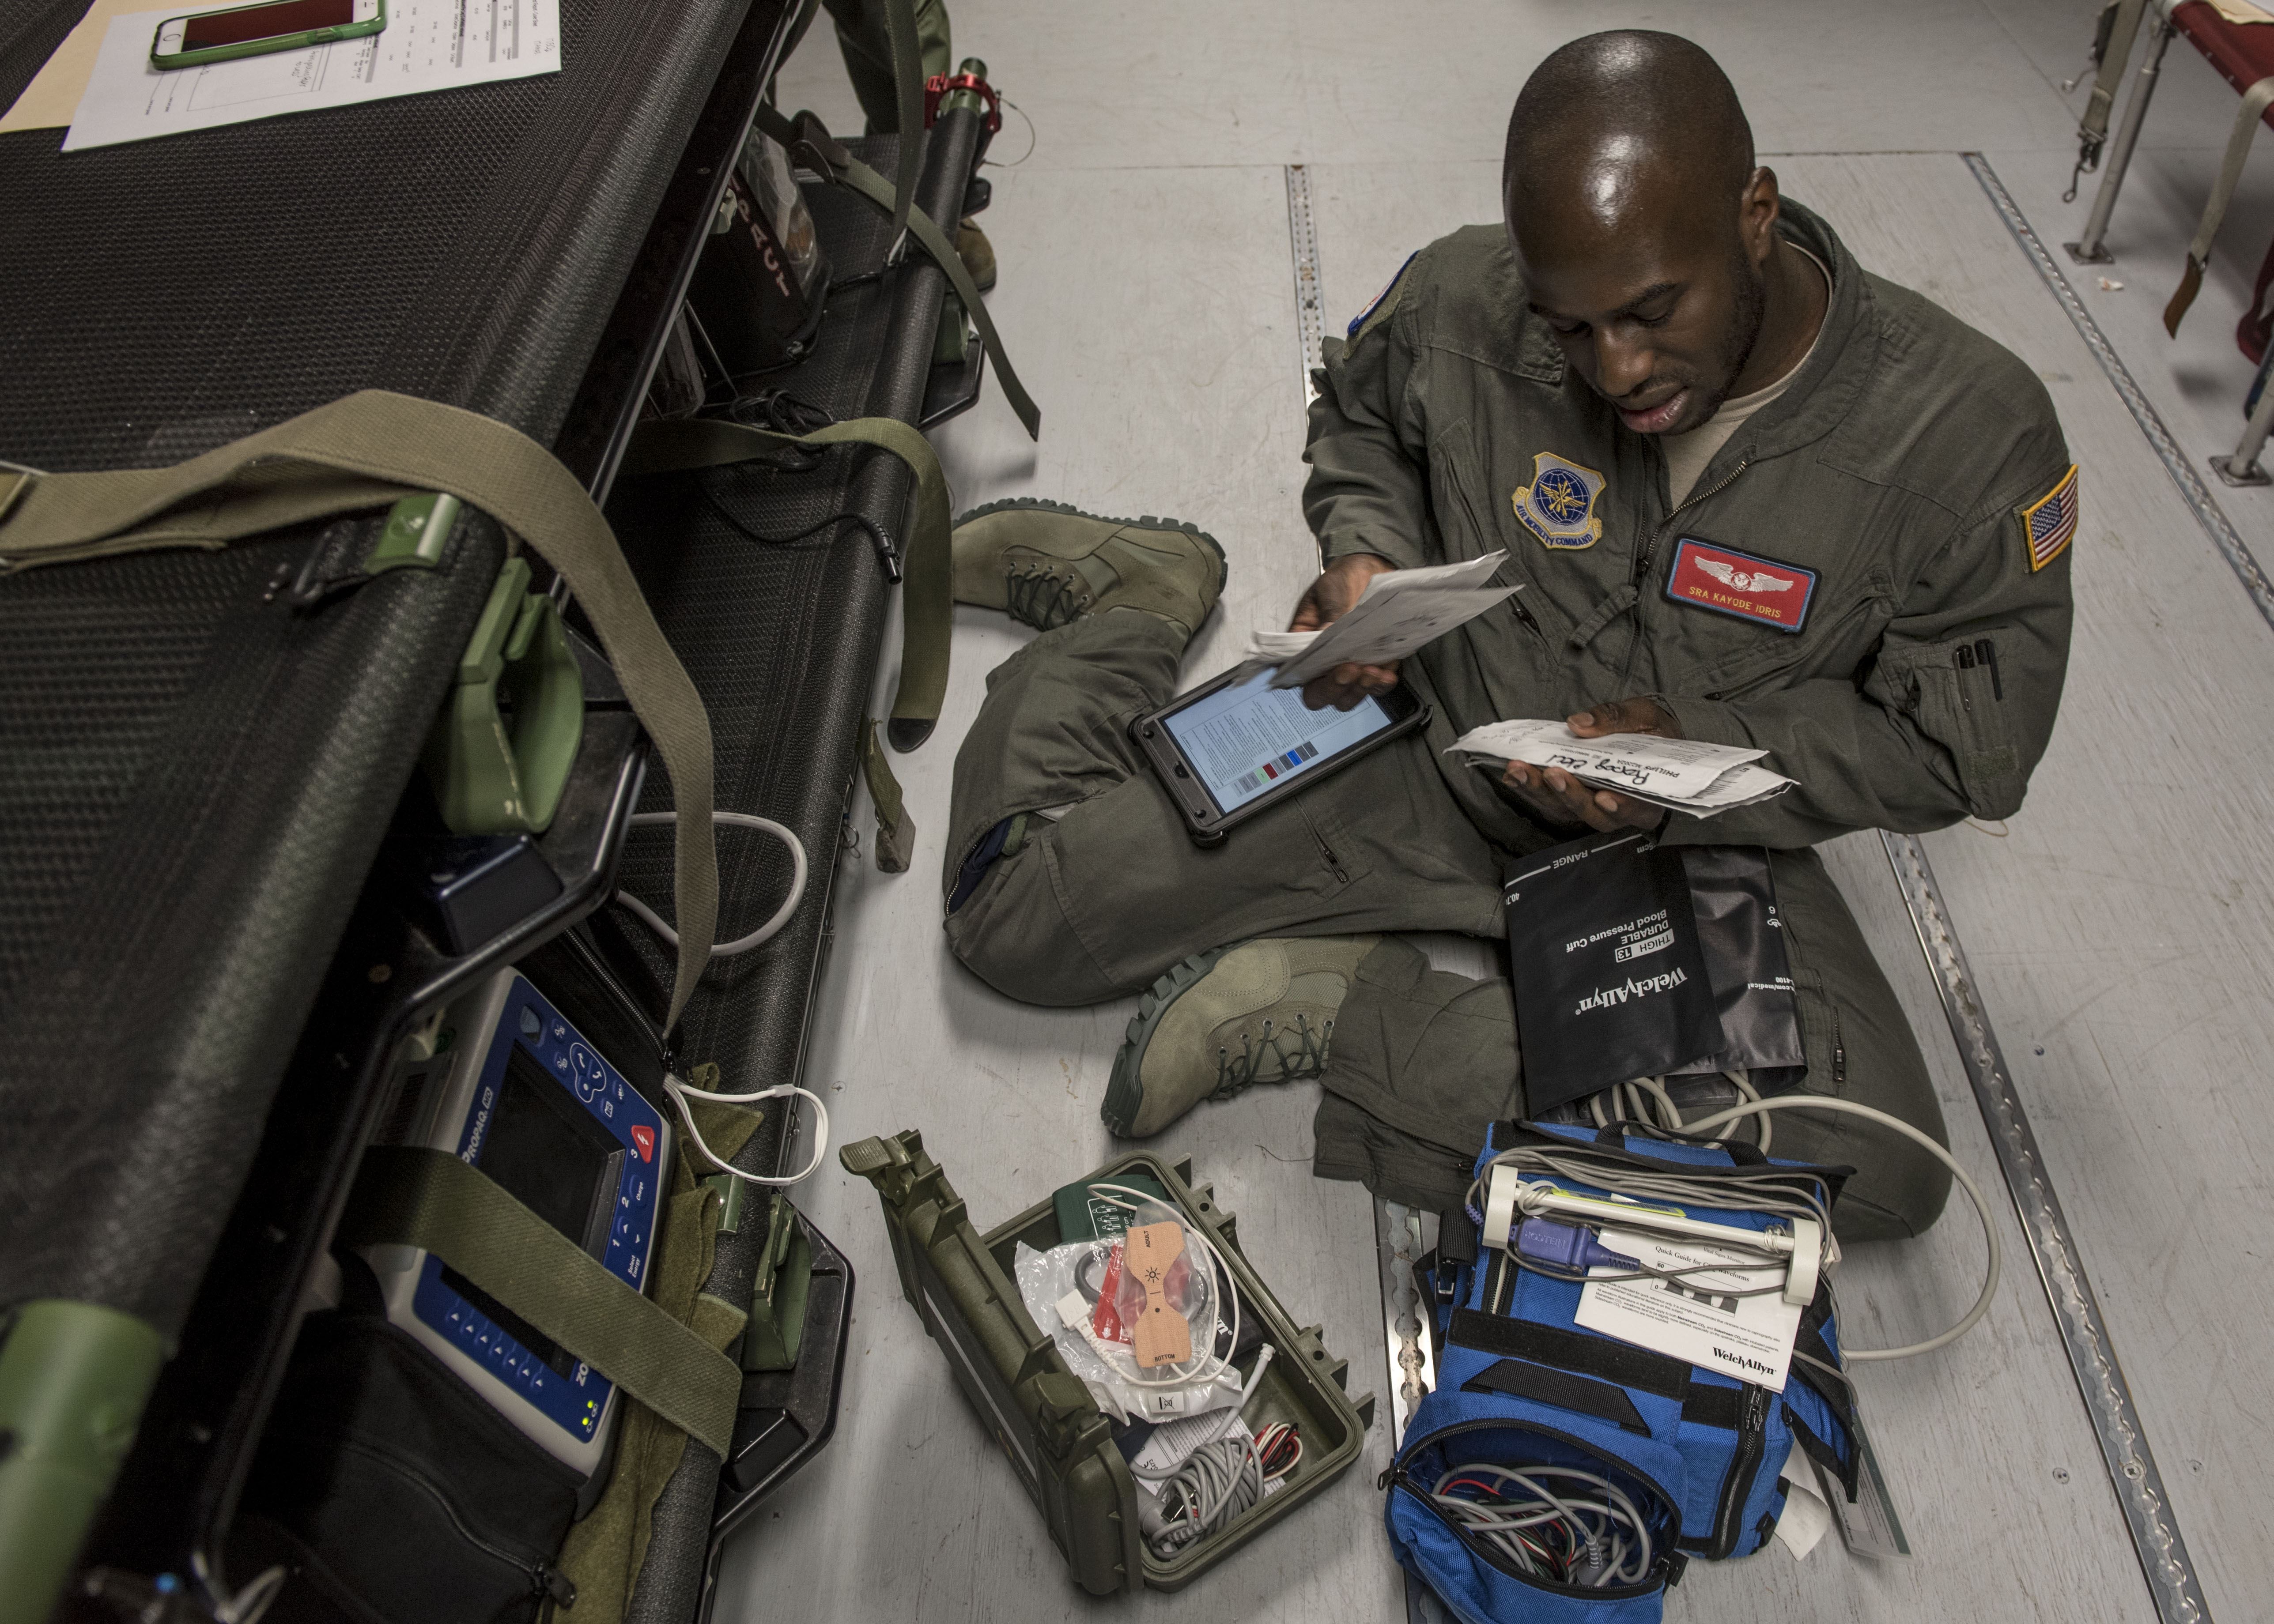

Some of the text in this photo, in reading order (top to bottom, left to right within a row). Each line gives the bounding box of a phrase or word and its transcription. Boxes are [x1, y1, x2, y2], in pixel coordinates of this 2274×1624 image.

[731, 177, 789, 297] PACT
[1516, 505, 1593, 546] AIR MOBILITY COMMAND
[1689, 586, 1781, 618] SRA KAYODE IDRIS
[1644, 766, 1680, 778] PHILIPS
[1553, 850, 1588, 869] RANGE
[1506, 893, 1519, 905] 40.7
[1566, 909, 1667, 953] Blood Pressure Cuff
[1621, 919, 1669, 944] DURABLE
[1617, 934, 1671, 959] THIGH 13
[461, 1111, 487, 1164] PROPAQ
[631, 1149, 638, 1159] 3
[622, 1196, 629, 1208] 2
[612, 1239, 620, 1247] 1
[1525, 1231, 1566, 1249] NELLCOR
[1655, 1246, 1673, 1256] Quick
[1674, 1253, 1691, 1262] Guide
[1727, 1255, 1745, 1265] Monitor
[627, 1255, 636, 1274] Select
[631, 1258, 640, 1278] Energy
[1594, 1296, 1613, 1304] Sidestream
[1595, 1292, 1614, 1300] Mainstream
[1623, 1301, 1641, 1310] waveforms
[1626, 1292, 1645, 1301] educational
[1617, 1295, 1636, 1304] illustrations
[1677, 1315, 1697, 1325] Mainstream
[1713, 1328, 1734, 1337] Sidestream
[1693, 1311, 1716, 1321] recommended
[1154, 1354, 1175, 1362] BOTTOM
[1148, 1459, 1158, 1470] 0473
